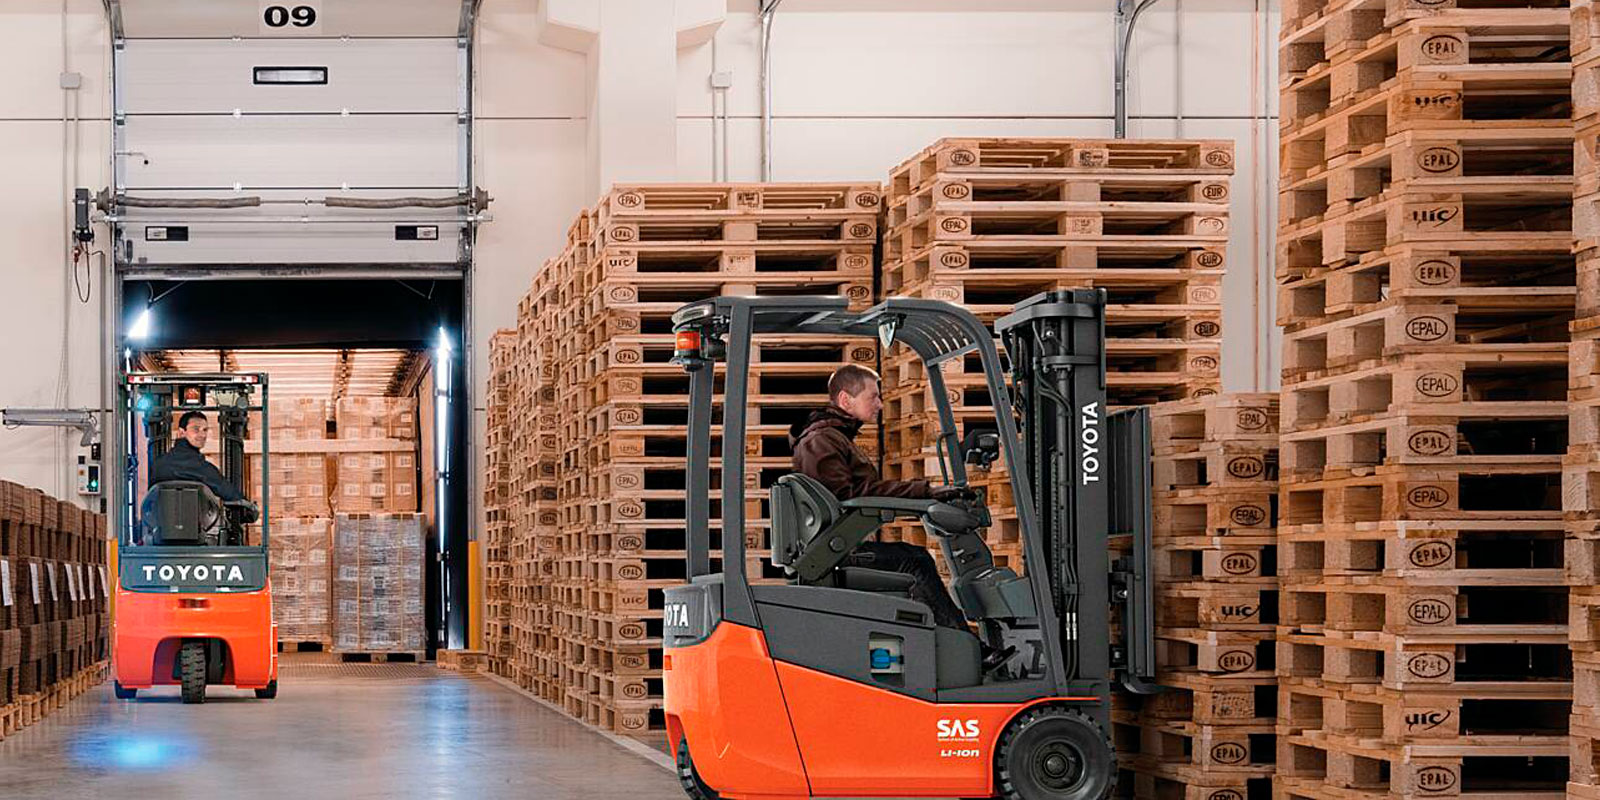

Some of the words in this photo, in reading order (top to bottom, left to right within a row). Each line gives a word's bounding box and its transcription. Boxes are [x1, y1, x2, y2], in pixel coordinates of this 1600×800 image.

[264, 6, 316, 27] 09
[1428, 42, 1456, 54] EPAL
[1424, 155, 1452, 166] EPAL
[1420, 267, 1449, 279] EPAL
[1411, 321, 1441, 335] EPAL
[1422, 377, 1451, 391] EPAL
[1239, 413, 1262, 424] EPAL
[1082, 401, 1099, 485] TOYOTA
[1415, 438, 1444, 449] EPAL
[1233, 462, 1257, 472] EPAL
[1414, 491, 1443, 502] EPAL
[1236, 510, 1259, 520] EPAL
[1416, 548, 1447, 561] EPAL
[1227, 557, 1250, 568] EPAL
[142, 565, 244, 581] TOYOTA
[664, 604, 689, 627] OTA
[1414, 606, 1444, 618] EPAL
[1224, 656, 1248, 666] EPAL
[937, 719, 980, 737] SAS
[1216, 748, 1241, 758] EPAL
[1420, 773, 1450, 785] EPAL
